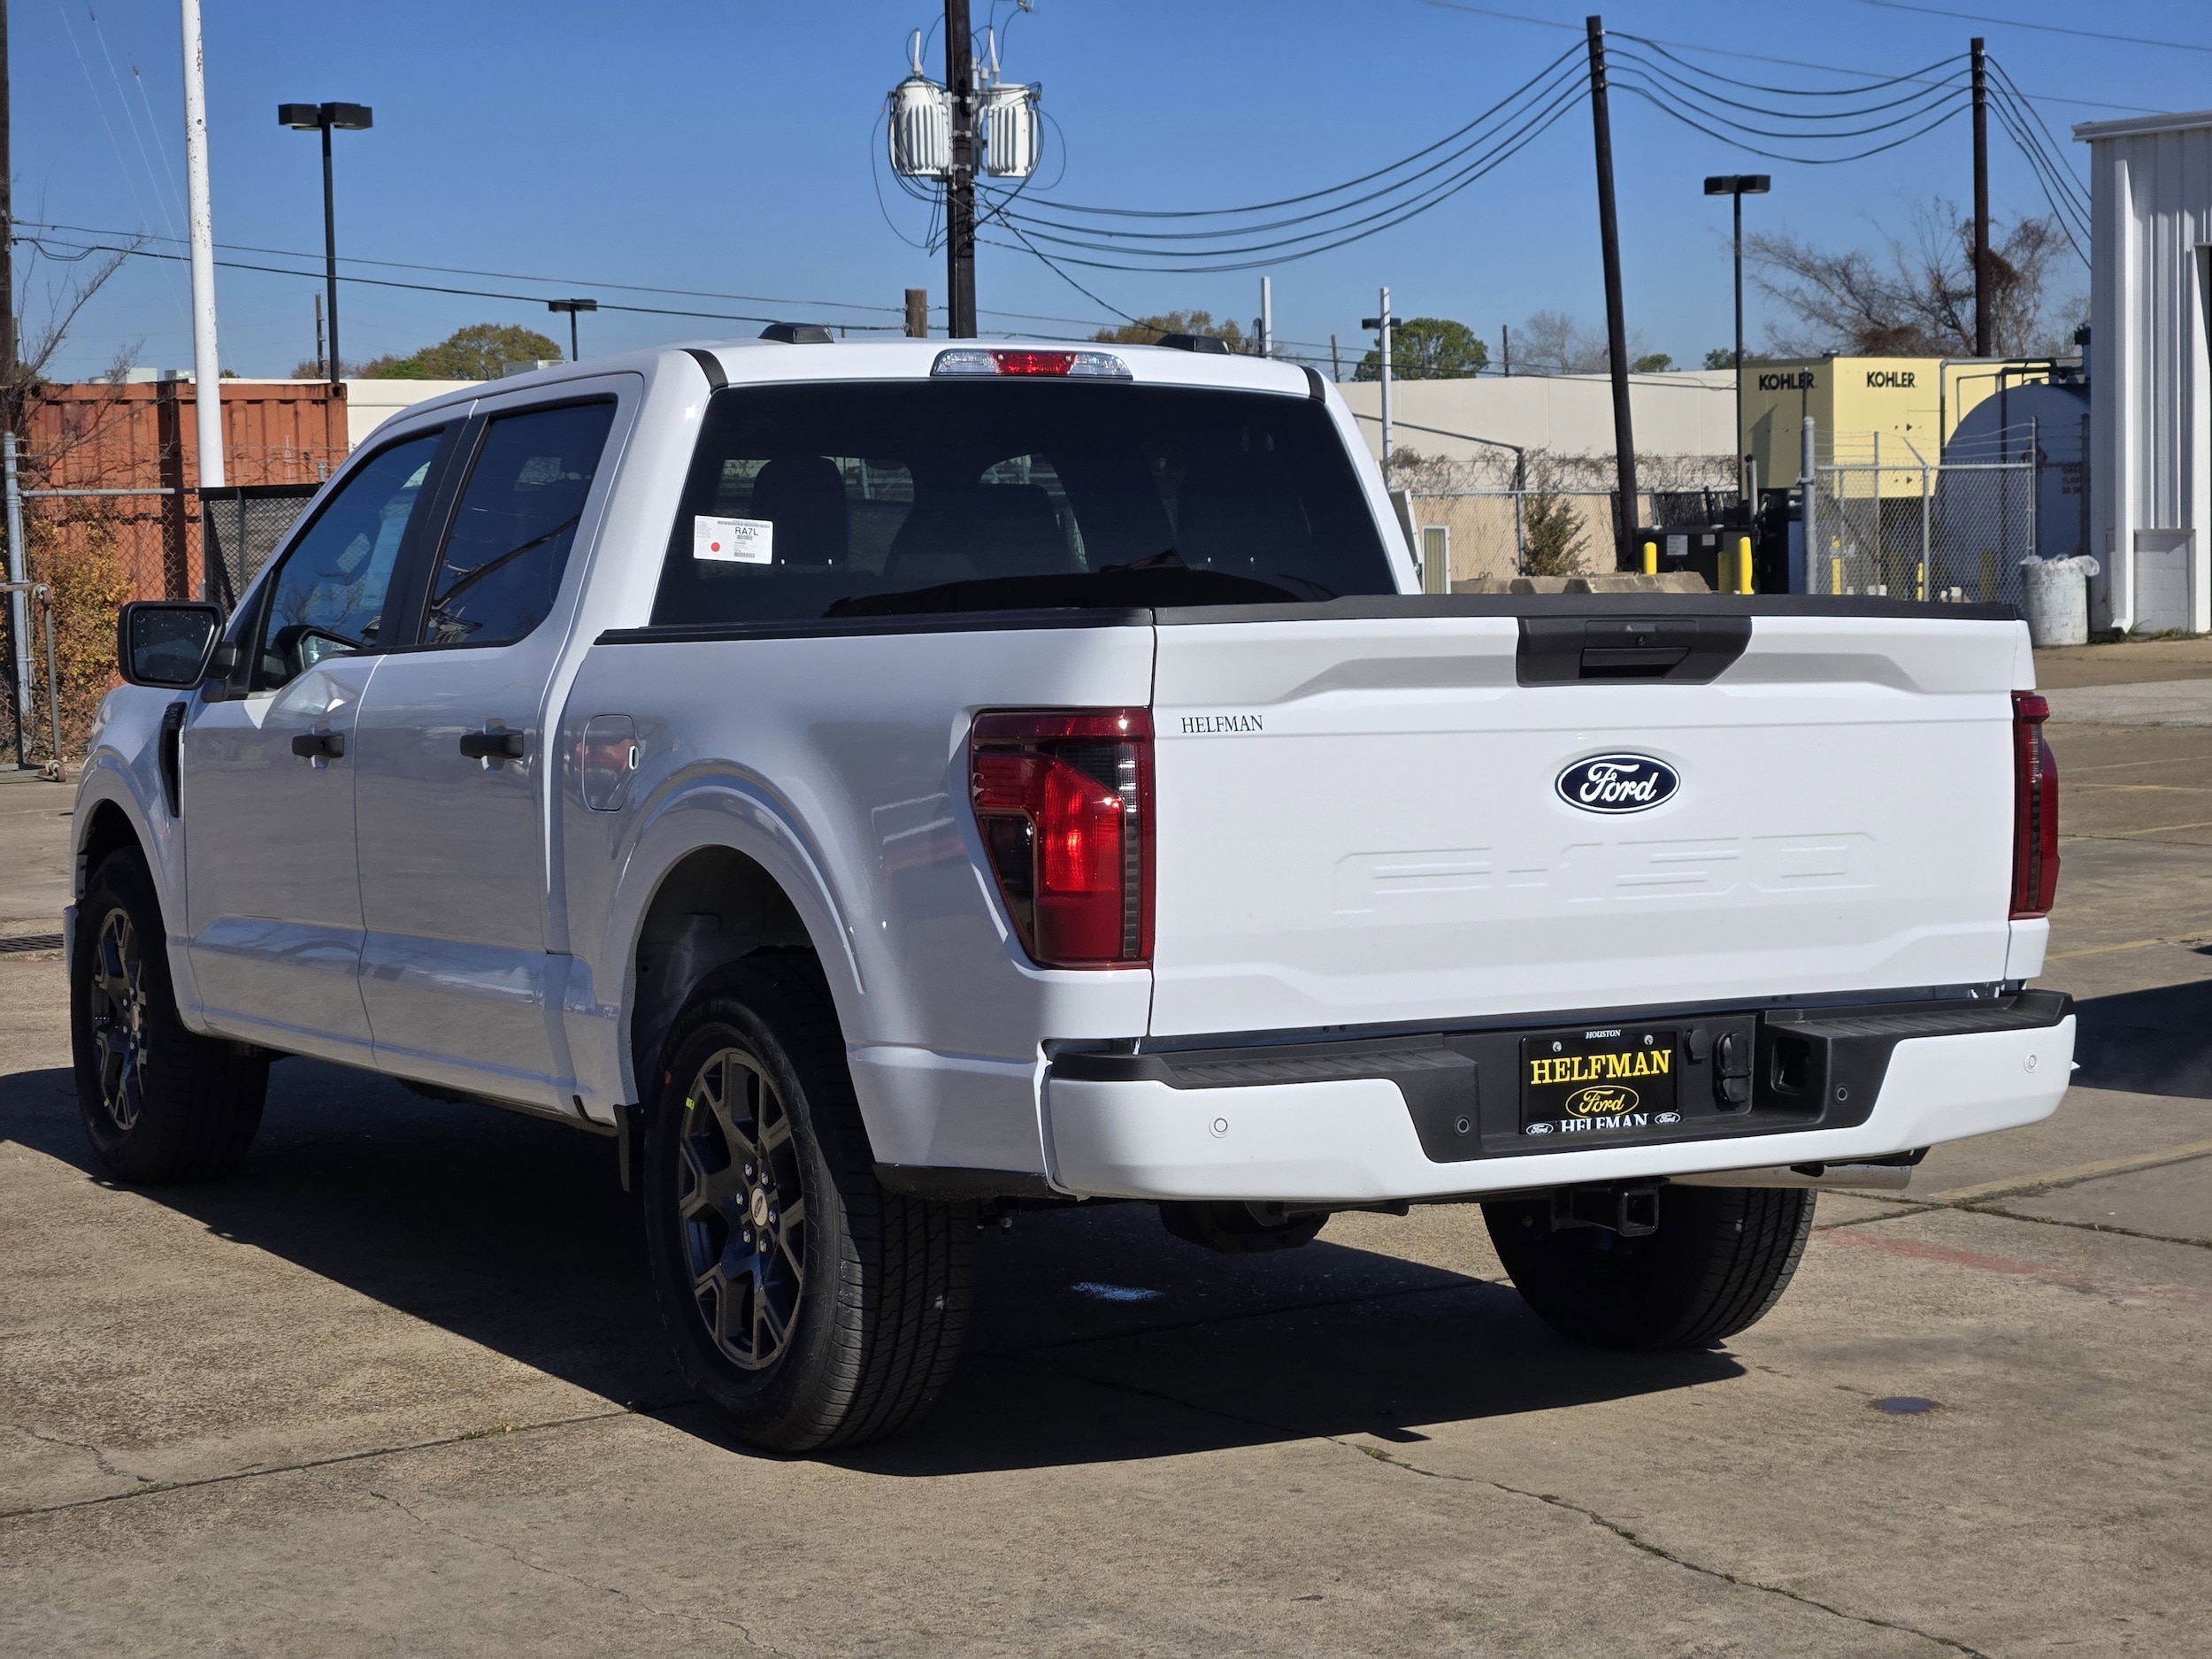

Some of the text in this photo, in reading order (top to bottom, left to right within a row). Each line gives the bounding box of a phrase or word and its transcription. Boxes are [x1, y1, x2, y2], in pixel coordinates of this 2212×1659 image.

[1759, 373, 1815, 391] KOHLER
[1866, 371, 1916, 388] KOHLER
[734, 526, 759, 536] RA7L
[1180, 714, 1263, 733] HELFMAN
[1579, 762, 1659, 803] Ford
[1585, 1029, 1622, 1040] HOUSTON
[1530, 1049, 1672, 1086] HELFMAN
[1578, 1089, 1626, 1114] Ford
[1560, 1112, 1649, 1133] HELFMAN
